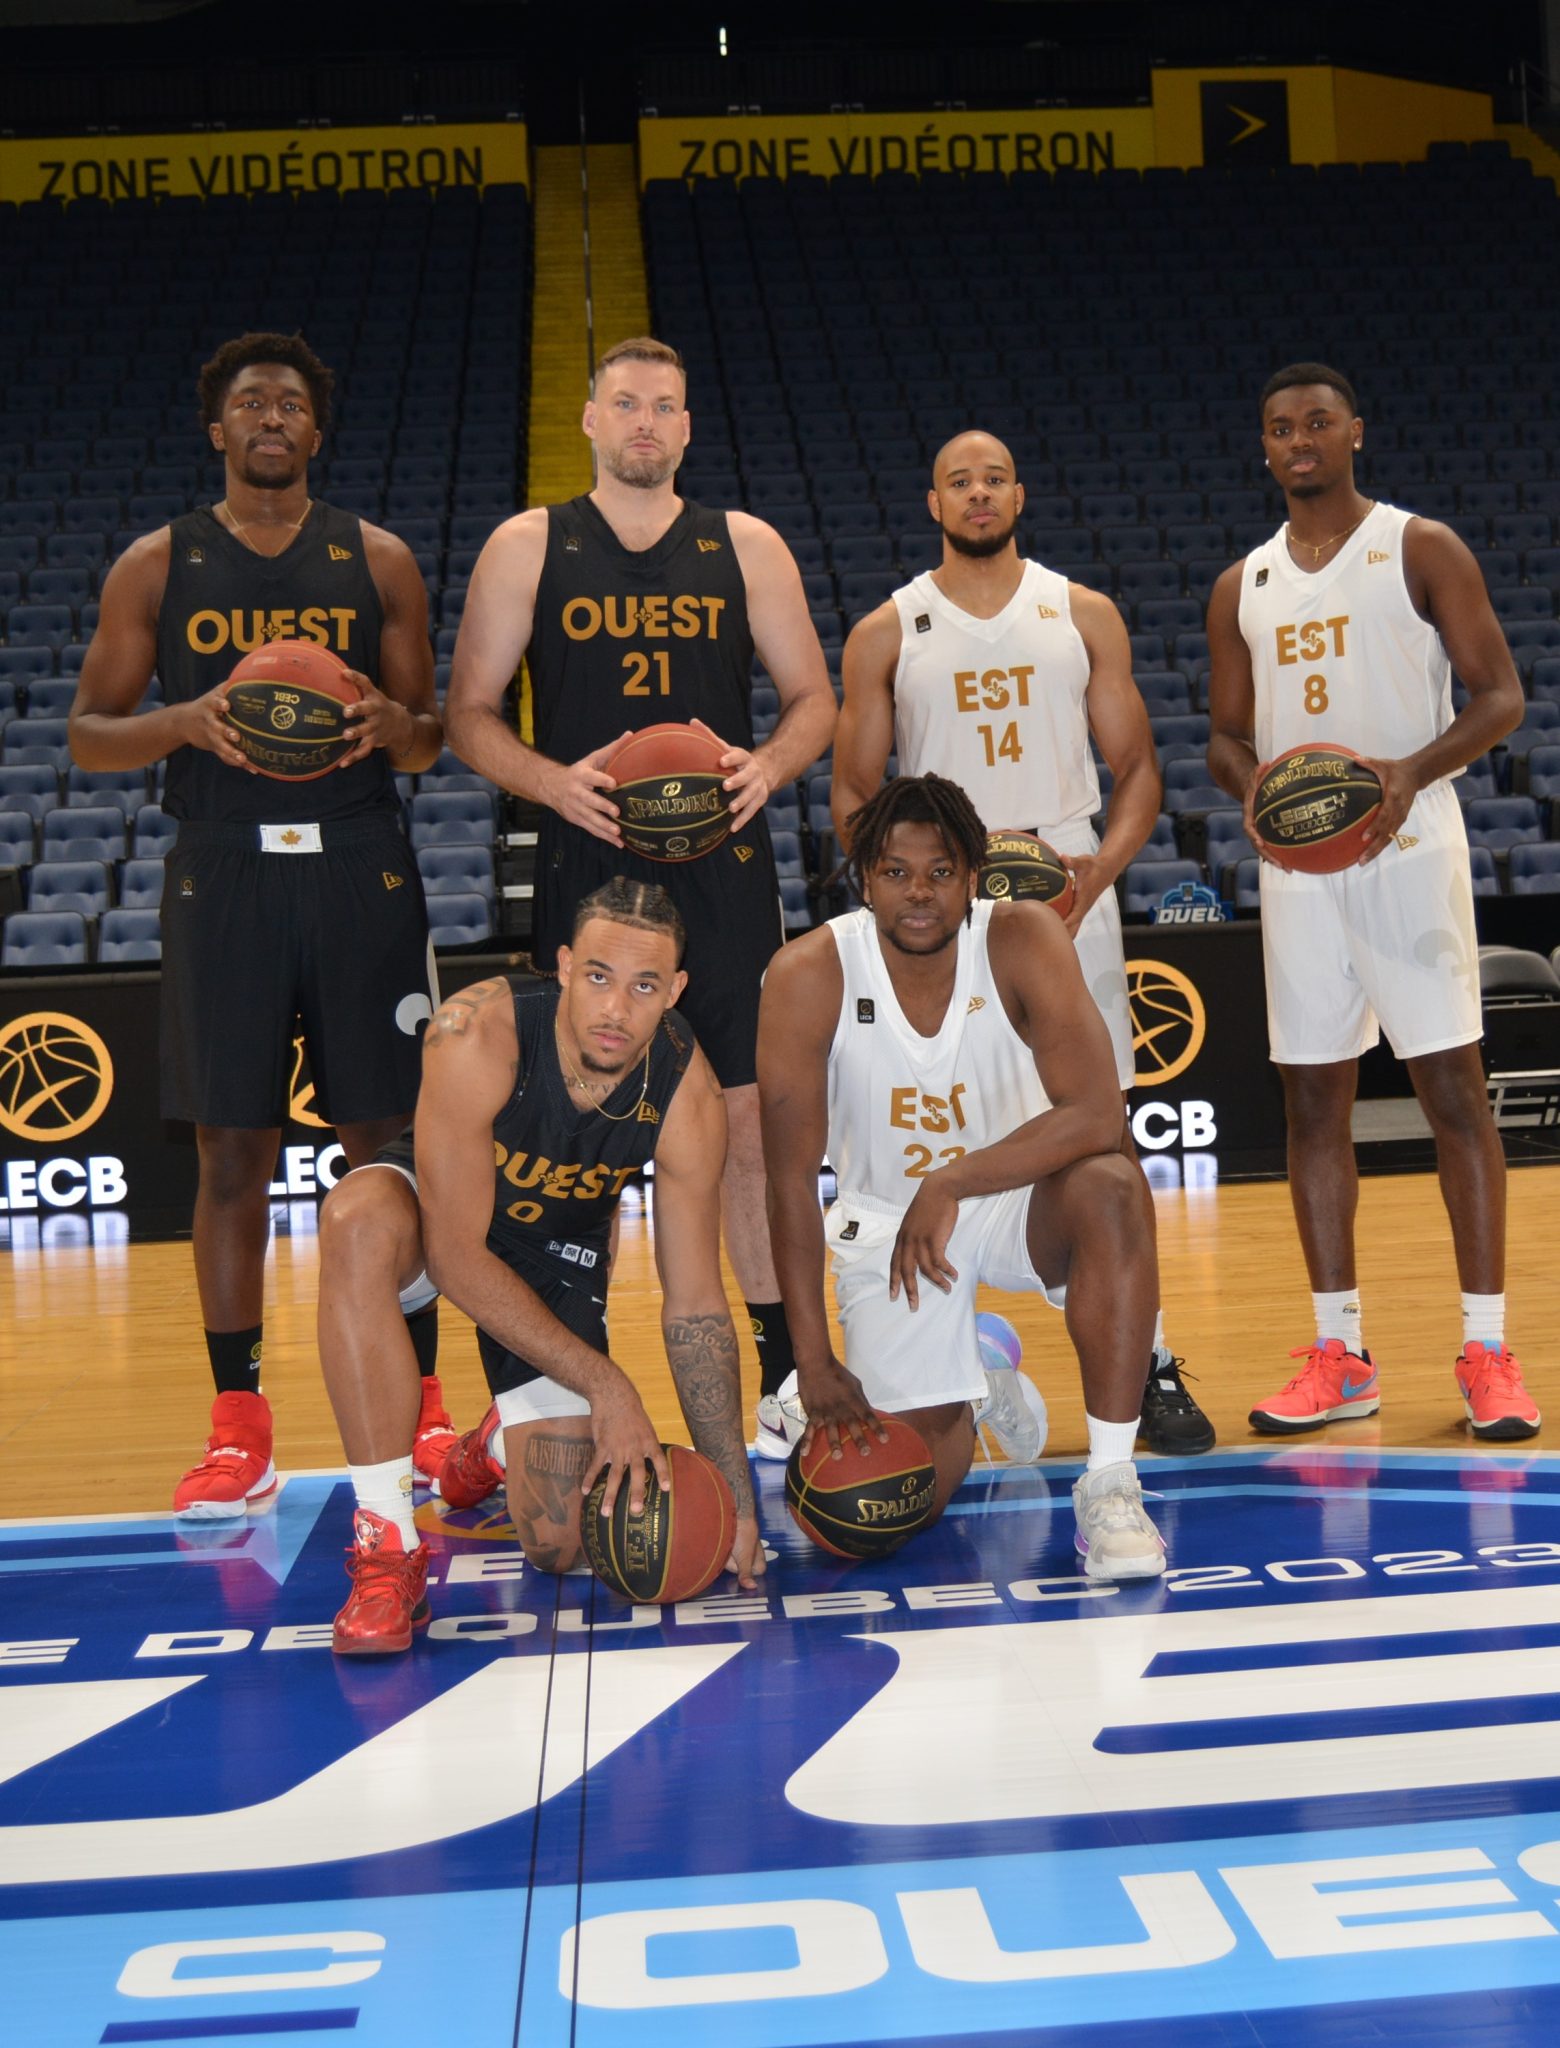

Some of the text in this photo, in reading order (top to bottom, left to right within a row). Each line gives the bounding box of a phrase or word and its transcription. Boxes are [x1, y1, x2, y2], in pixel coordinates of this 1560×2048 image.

[39, 141, 484, 200] ZONE VIDÉOTRON
[679, 123, 1115, 178] ZONE VIDÉOTRON
[186, 607, 357, 654] OUEST
[562, 595, 725, 641] OUEST
[1275, 615, 1350, 666] EST
[622, 651, 671, 696] 21
[954, 665, 1035, 713] EST
[1304, 674, 1329, 715] 8
[239, 736, 332, 766] SPALDIN
[977, 721, 1023, 767] 14
[626, 787, 722, 819] SPALDING
[1262, 760, 1346, 801] SPALDING
[1269, 791, 1349, 829] LEGACY
[1158, 906, 1220, 924] DUEL
[890, 1083, 968, 1134] EST
[1126, 1100, 1218, 1150] CB
[0, 1156, 128, 1211] ECB
[857, 1479, 936, 1523] SPALDIN
[585, 1481, 614, 1578] SPALDIN
[134, 1623, 335, 1658] DE
[1161, 1543, 1560, 1592] 2023
[559, 1838, 1560, 2011] OUE
